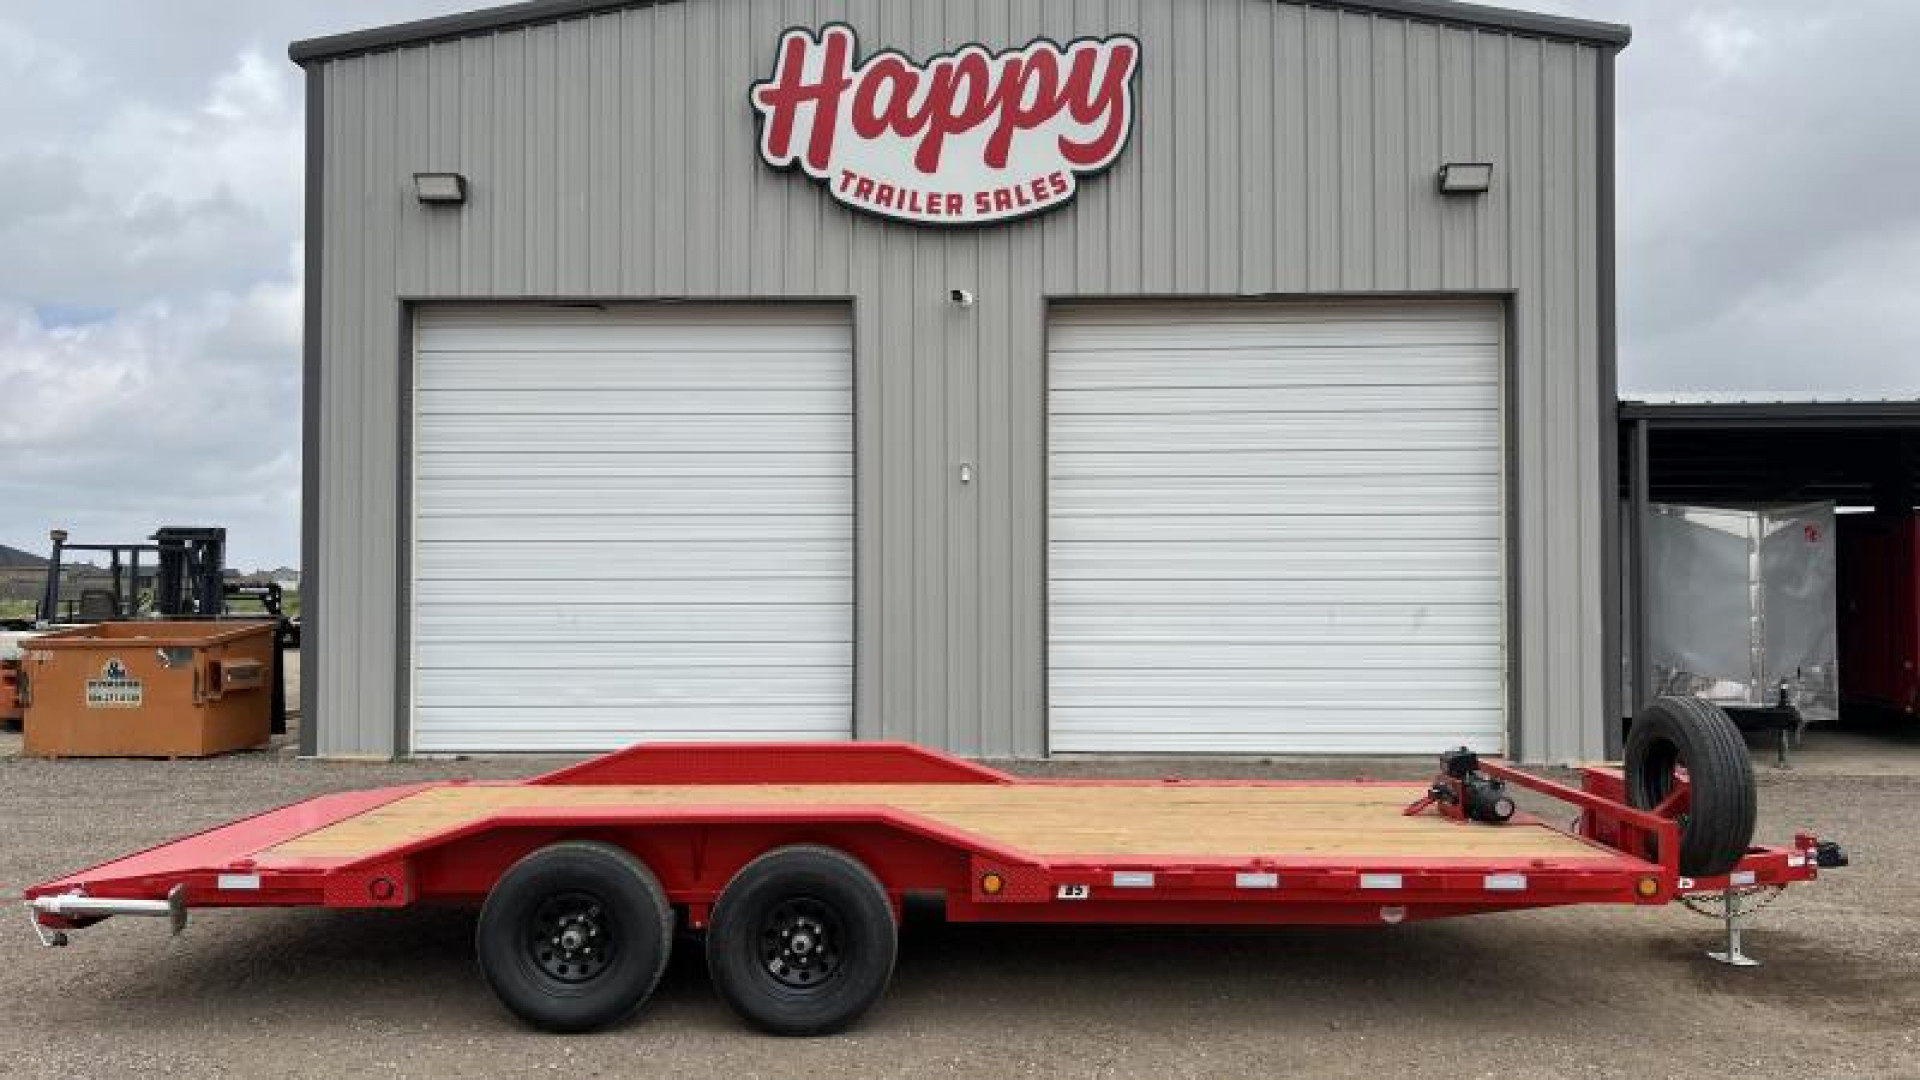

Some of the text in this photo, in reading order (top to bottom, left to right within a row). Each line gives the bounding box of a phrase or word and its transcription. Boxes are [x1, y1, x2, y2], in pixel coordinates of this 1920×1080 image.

[759, 30, 1134, 174] Happy
[839, 168, 1068, 216] TRAILER SALES
